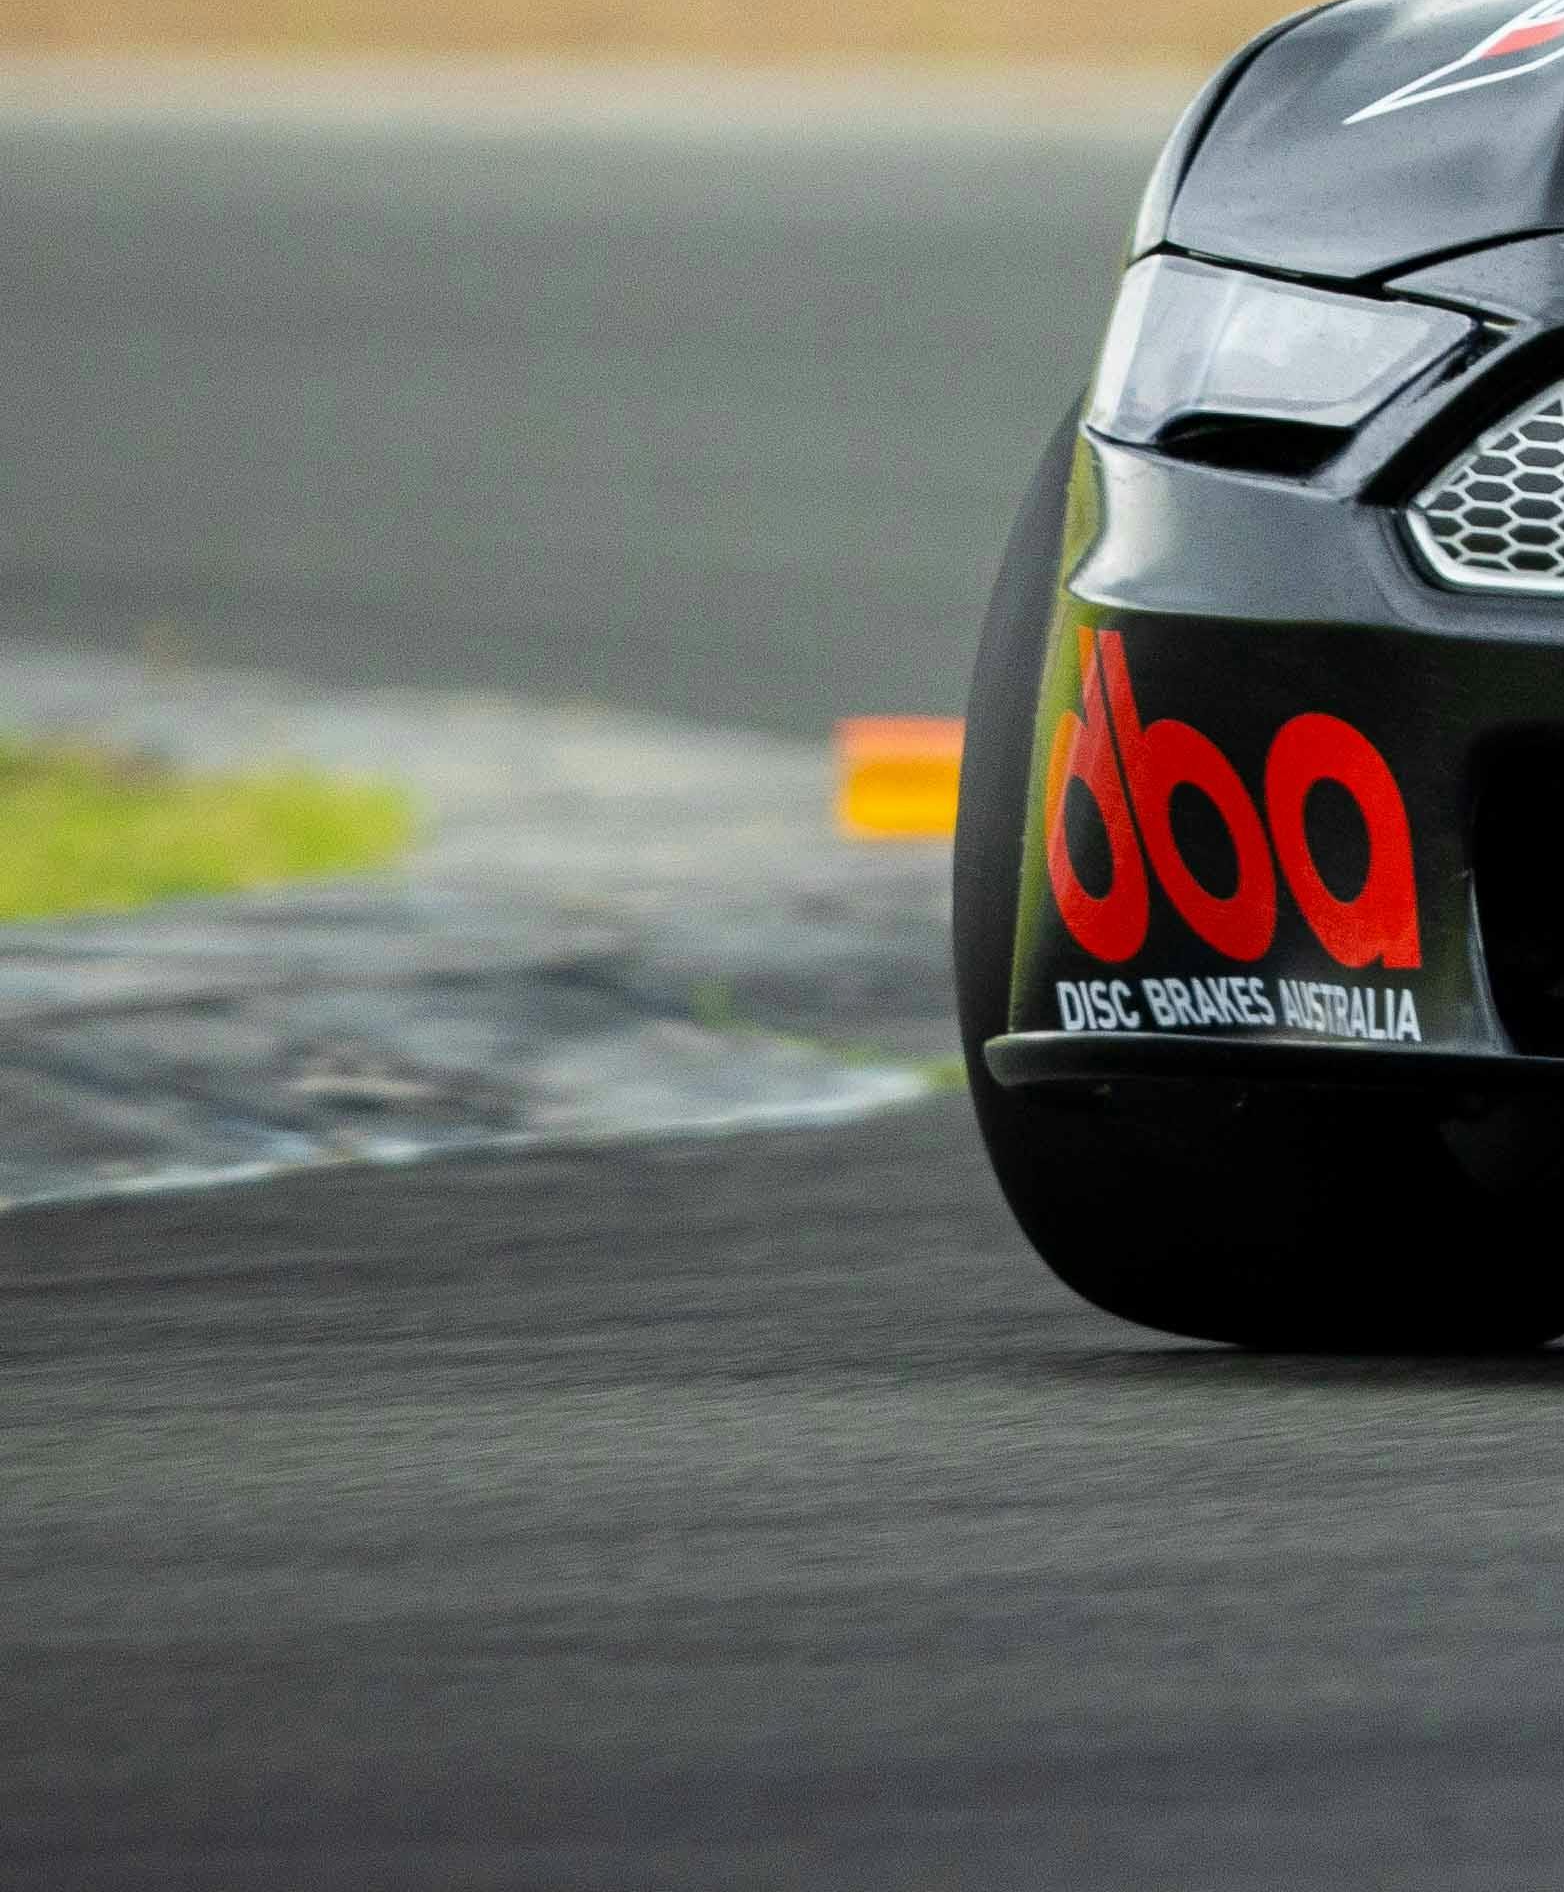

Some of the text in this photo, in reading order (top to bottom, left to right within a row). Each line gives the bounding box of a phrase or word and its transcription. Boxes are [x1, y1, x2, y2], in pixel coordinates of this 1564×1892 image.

[1045, 626, 1422, 969] dba
[1056, 976, 1422, 1042] DISC BRAKES AUSTRALIA
